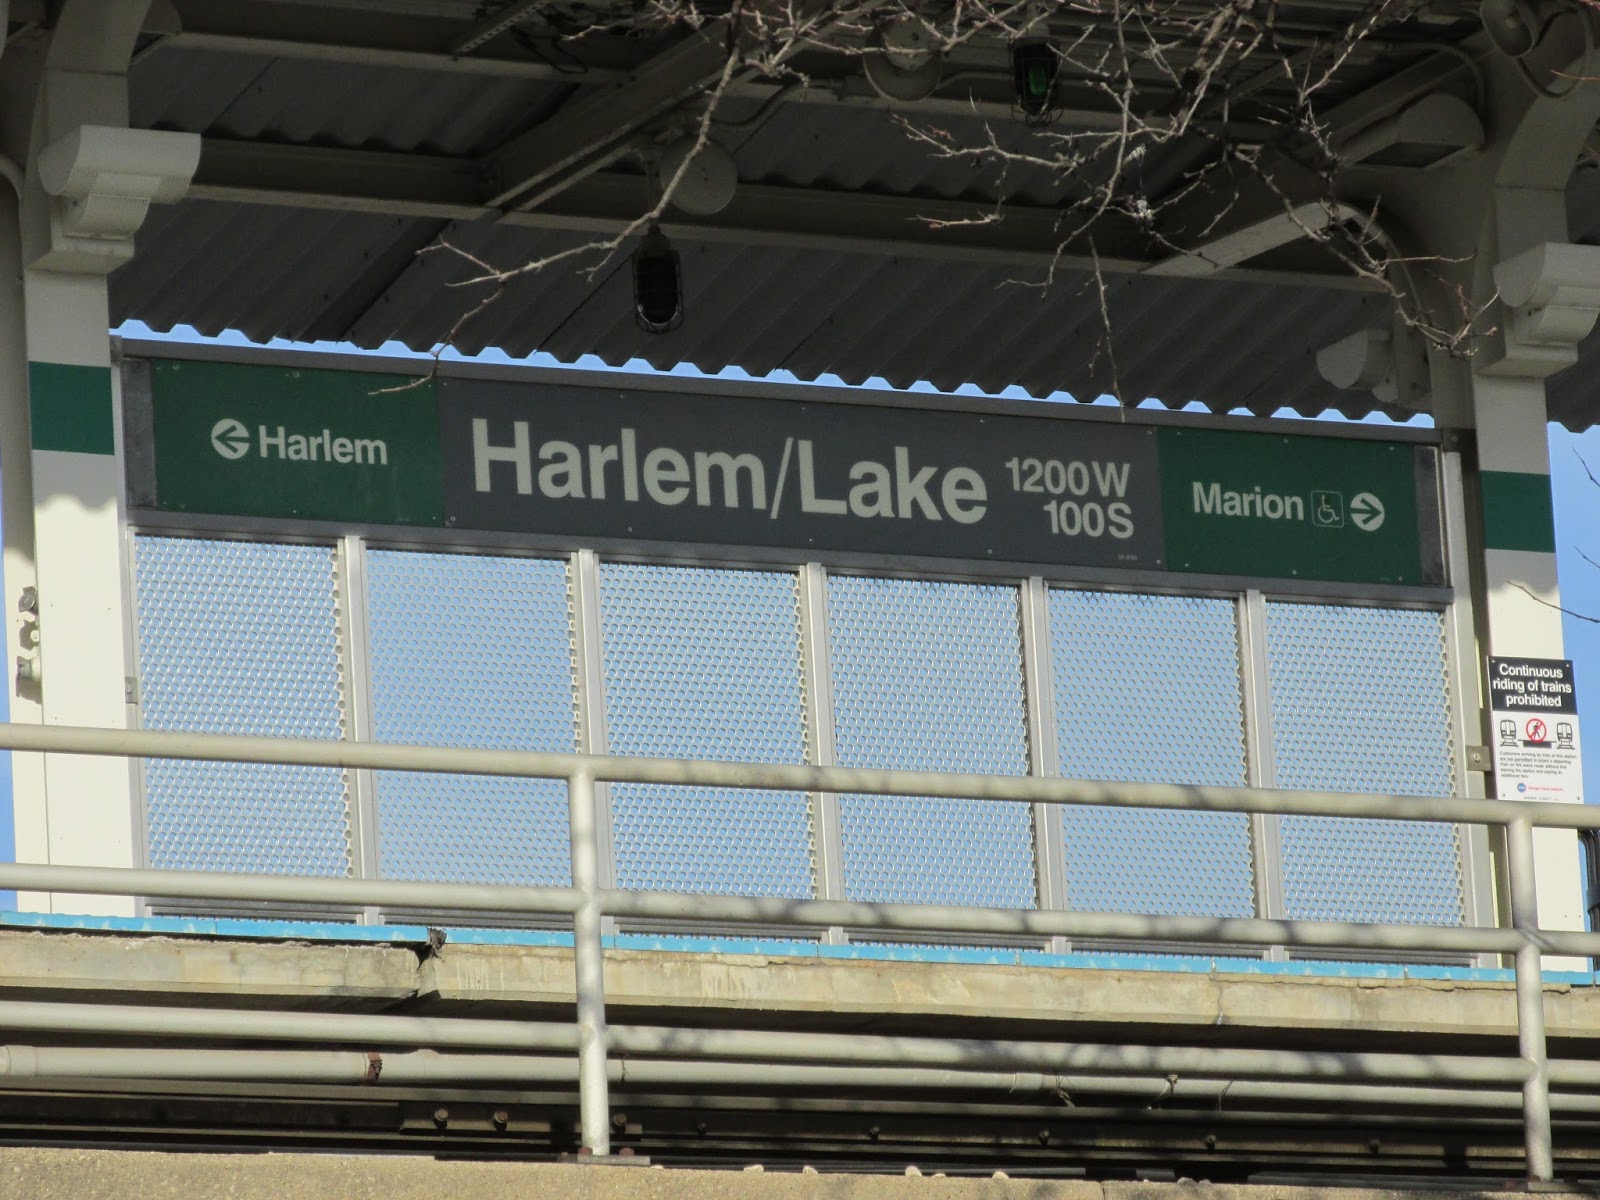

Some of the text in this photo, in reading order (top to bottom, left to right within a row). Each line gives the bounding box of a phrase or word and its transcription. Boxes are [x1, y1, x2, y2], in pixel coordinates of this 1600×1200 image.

[259, 424, 388, 465] Harlem
[472, 418, 988, 524] Harlem/Lake
[1004, 457, 1132, 498] 1200W
[1043, 499, 1135, 539] 100S
[1192, 481, 1305, 521] Marion
[1493, 678, 1572, 693] riding of trains
[1500, 663, 1563, 679] Continuous
[1506, 694, 1562, 707] prohibited
